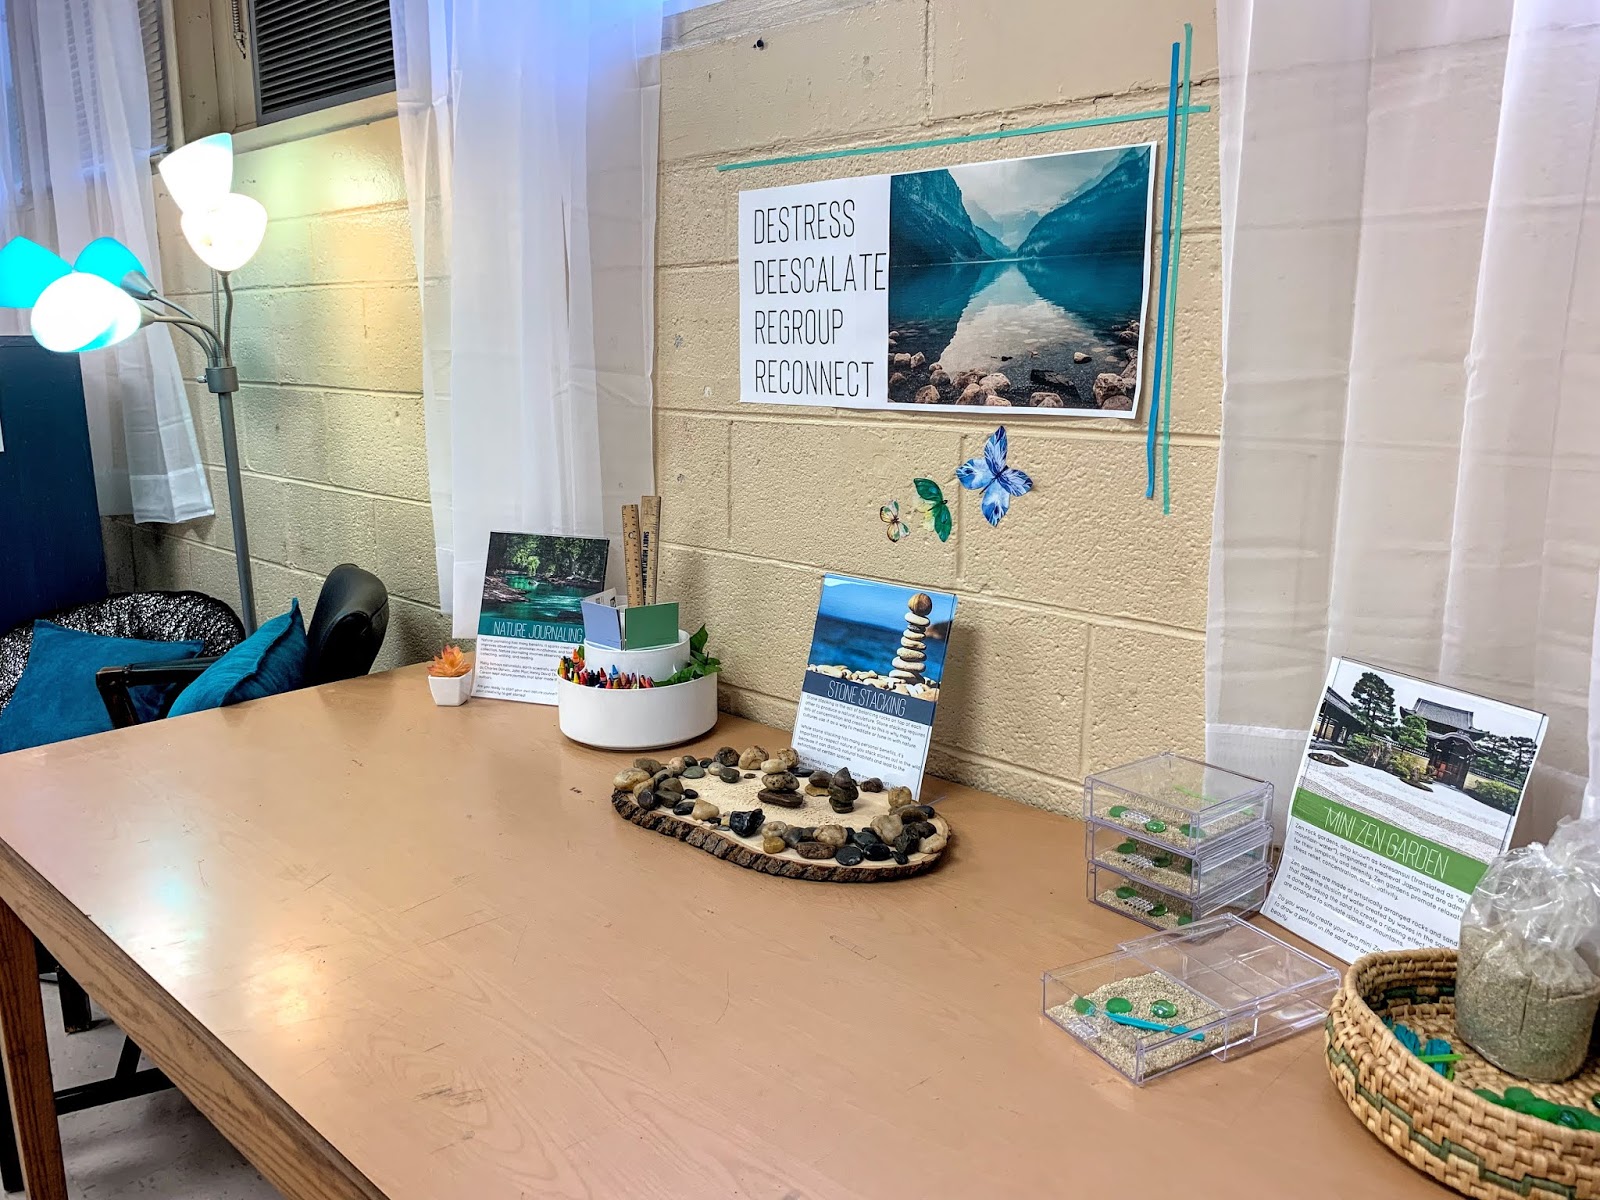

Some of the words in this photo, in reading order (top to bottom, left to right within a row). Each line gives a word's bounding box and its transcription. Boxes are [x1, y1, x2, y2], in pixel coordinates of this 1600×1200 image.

[754, 199, 855, 244] DESTRESS
[754, 253, 886, 295] DEESCALATE
[754, 309, 844, 345] REGROUP
[754, 360, 874, 398] RECONNECT
[493, 621, 527, 638] NATURE
[528, 624, 583, 643] JOURNALING
[827, 680, 858, 704] STONE
[858, 688, 907, 717] STACKING
[1293, 845, 1306, 855] stress
[1322, 859, 1358, 880] concentration,
[1359, 877, 1370, 886] and
[1295, 822, 1304, 830] Zen
[1317, 834, 1339, 847] gardens,
[1340, 844, 1351, 852] also
[1352, 848, 1370, 861] known
[1379, 861, 1410, 879] karesansui
[1411, 875, 1444, 894] (translated
[1324, 806, 1356, 839] MINI
[1355, 819, 1387, 852] ZEN
[1385, 832, 1449, 879] GARDEN
[1301, 841, 1313, 849] their
[1314, 847, 1338, 863] simplicity
[1373, 874, 1384, 884] Zen
[1385, 882, 1409, 896] gardens
[1410, 893, 1436, 909] promote
[1339, 852, 1367, 868] originated
[1374, 868, 1400, 883] medieval
[1401, 881, 1420, 892] Japan
[1422, 890, 1434, 899] and
[1435, 896, 1446, 904] are
[1277, 893, 1285, 901] Do
[1295, 904, 1308, 913] want
[1315, 915, 1332, 927] create
[1333, 924, 1345, 933] your
[1346, 931, 1358, 940] own
[1358, 938, 1372, 948] mini
[1280, 904, 1293, 914] draw
[1298, 914, 1317, 927] pattern
[1324, 928, 1333, 936] the
[1334, 934, 1348, 944] sand
[1347, 942, 1359, 950] and
[1288, 866, 1299, 874] that
[1299, 872, 1313, 882] make
[1314, 879, 1323, 887] the
[1323, 884, 1341, 896] illusion
[1348, 897, 1364, 907] water
[1365, 905, 1387, 919] created
[1387, 916, 1395, 924] by
[1396, 921, 1414, 934] waves
[1423, 934, 1433, 943] the
[1434, 941, 1449, 950] san
[1290, 858, 1300, 867] Zen
[1300, 865, 1320, 877] gardens
[1331, 880, 1346, 890] made
[1353, 891, 1382, 909] artistically
[1383, 906, 1410, 922] arranged
[1411, 920, 1428, 932] rocks
[1429, 929, 1441, 938] and
[1442, 935, 1458, 946] sand
[1291, 876, 1304, 886] done
[1304, 882, 1311, 890] by
[1312, 887, 1328, 899] raking
[1329, 895, 1338, 903] the
[1339, 901, 1352, 910] sand
[1359, 911, 1377, 924] create
[1383, 924, 1406, 939] rippling
[1292, 886, 1316, 900] arranged
[1323, 901, 1345, 916] simulate
[1345, 914, 1364, 926] islands
[1372, 927, 1403, 946] mountains.
